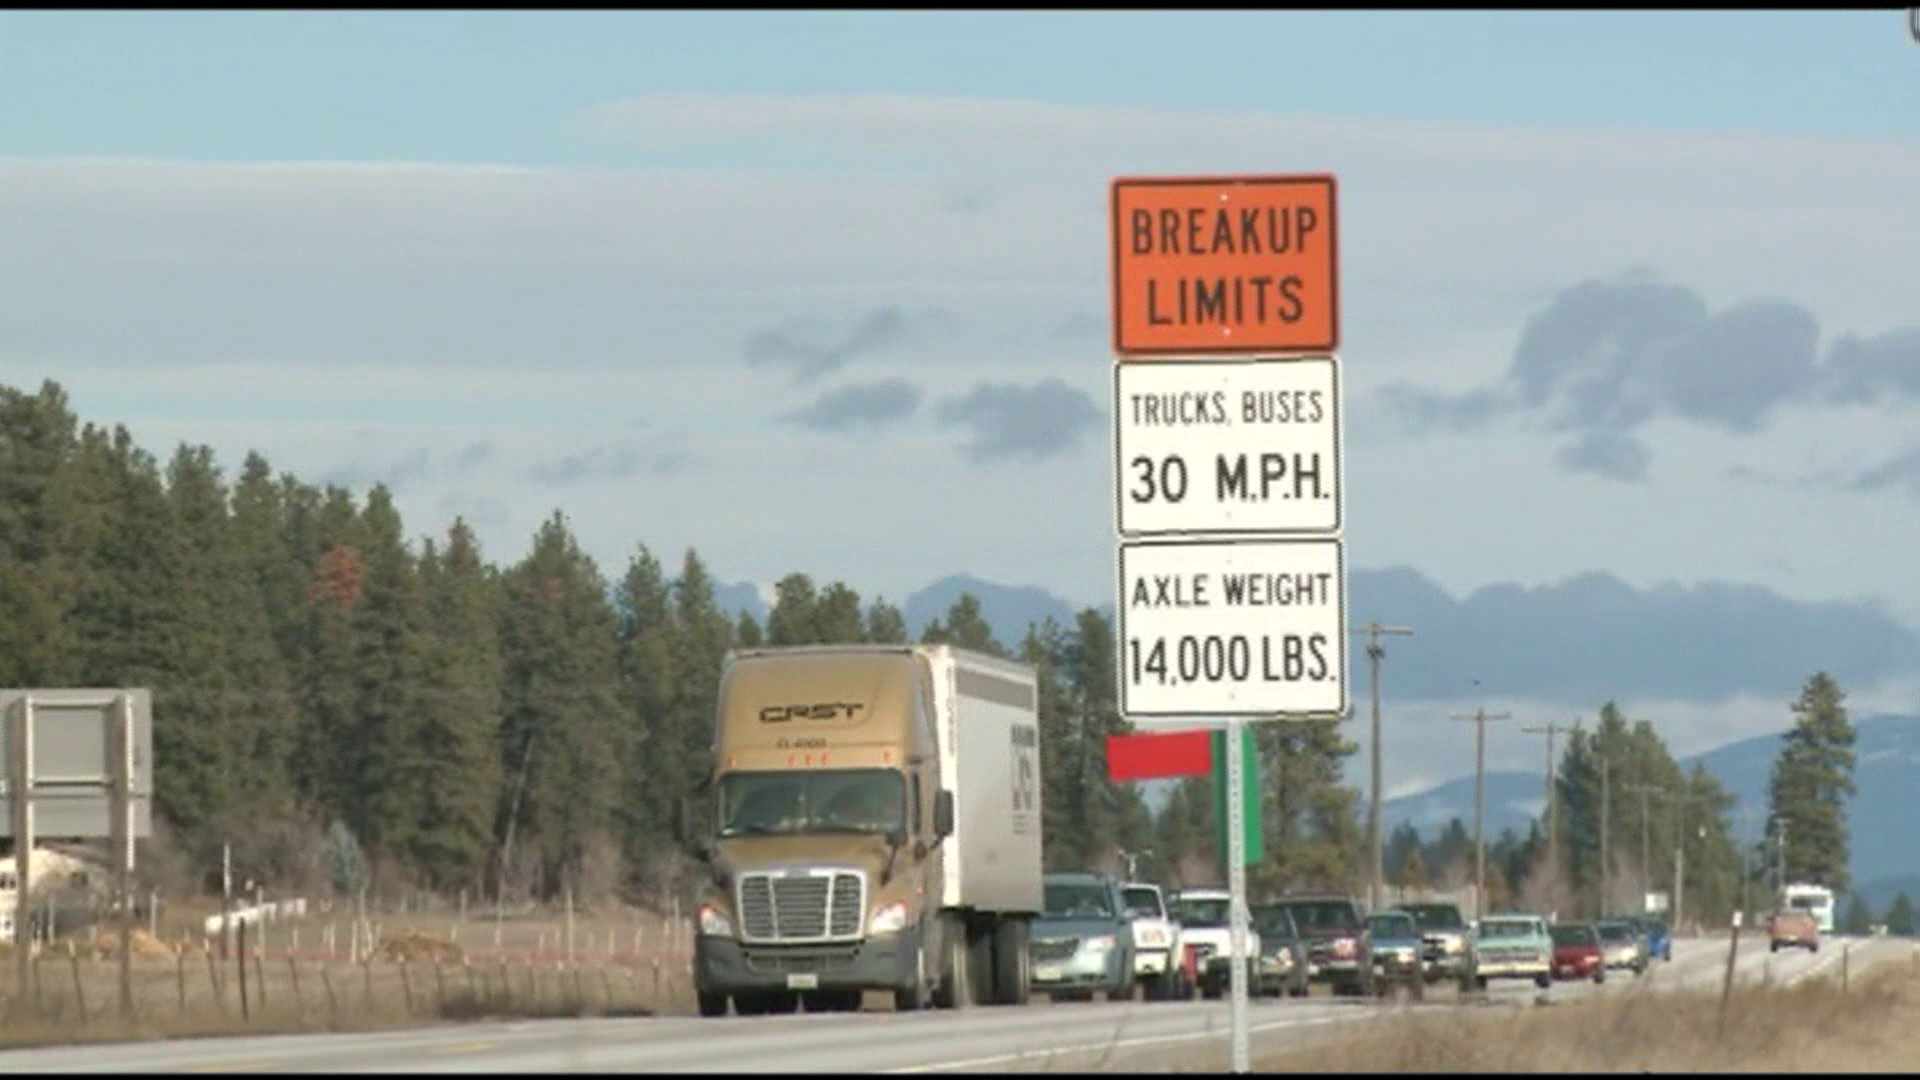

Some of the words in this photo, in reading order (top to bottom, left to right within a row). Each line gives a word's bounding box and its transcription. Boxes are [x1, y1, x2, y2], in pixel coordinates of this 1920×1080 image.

[1131, 207, 1318, 256] BREAKUP
[1147, 275, 1304, 325] LIMITS
[1241, 390, 1324, 424] BUSES
[1130, 455, 1188, 504] 30
[1215, 452, 1330, 503] M.P.H.
[1132, 574, 1209, 609] AXLE
[1222, 573, 1332, 606] WEIGHT
[1262, 633, 1337, 683] LBS.
[759, 702, 864, 723] CRST
